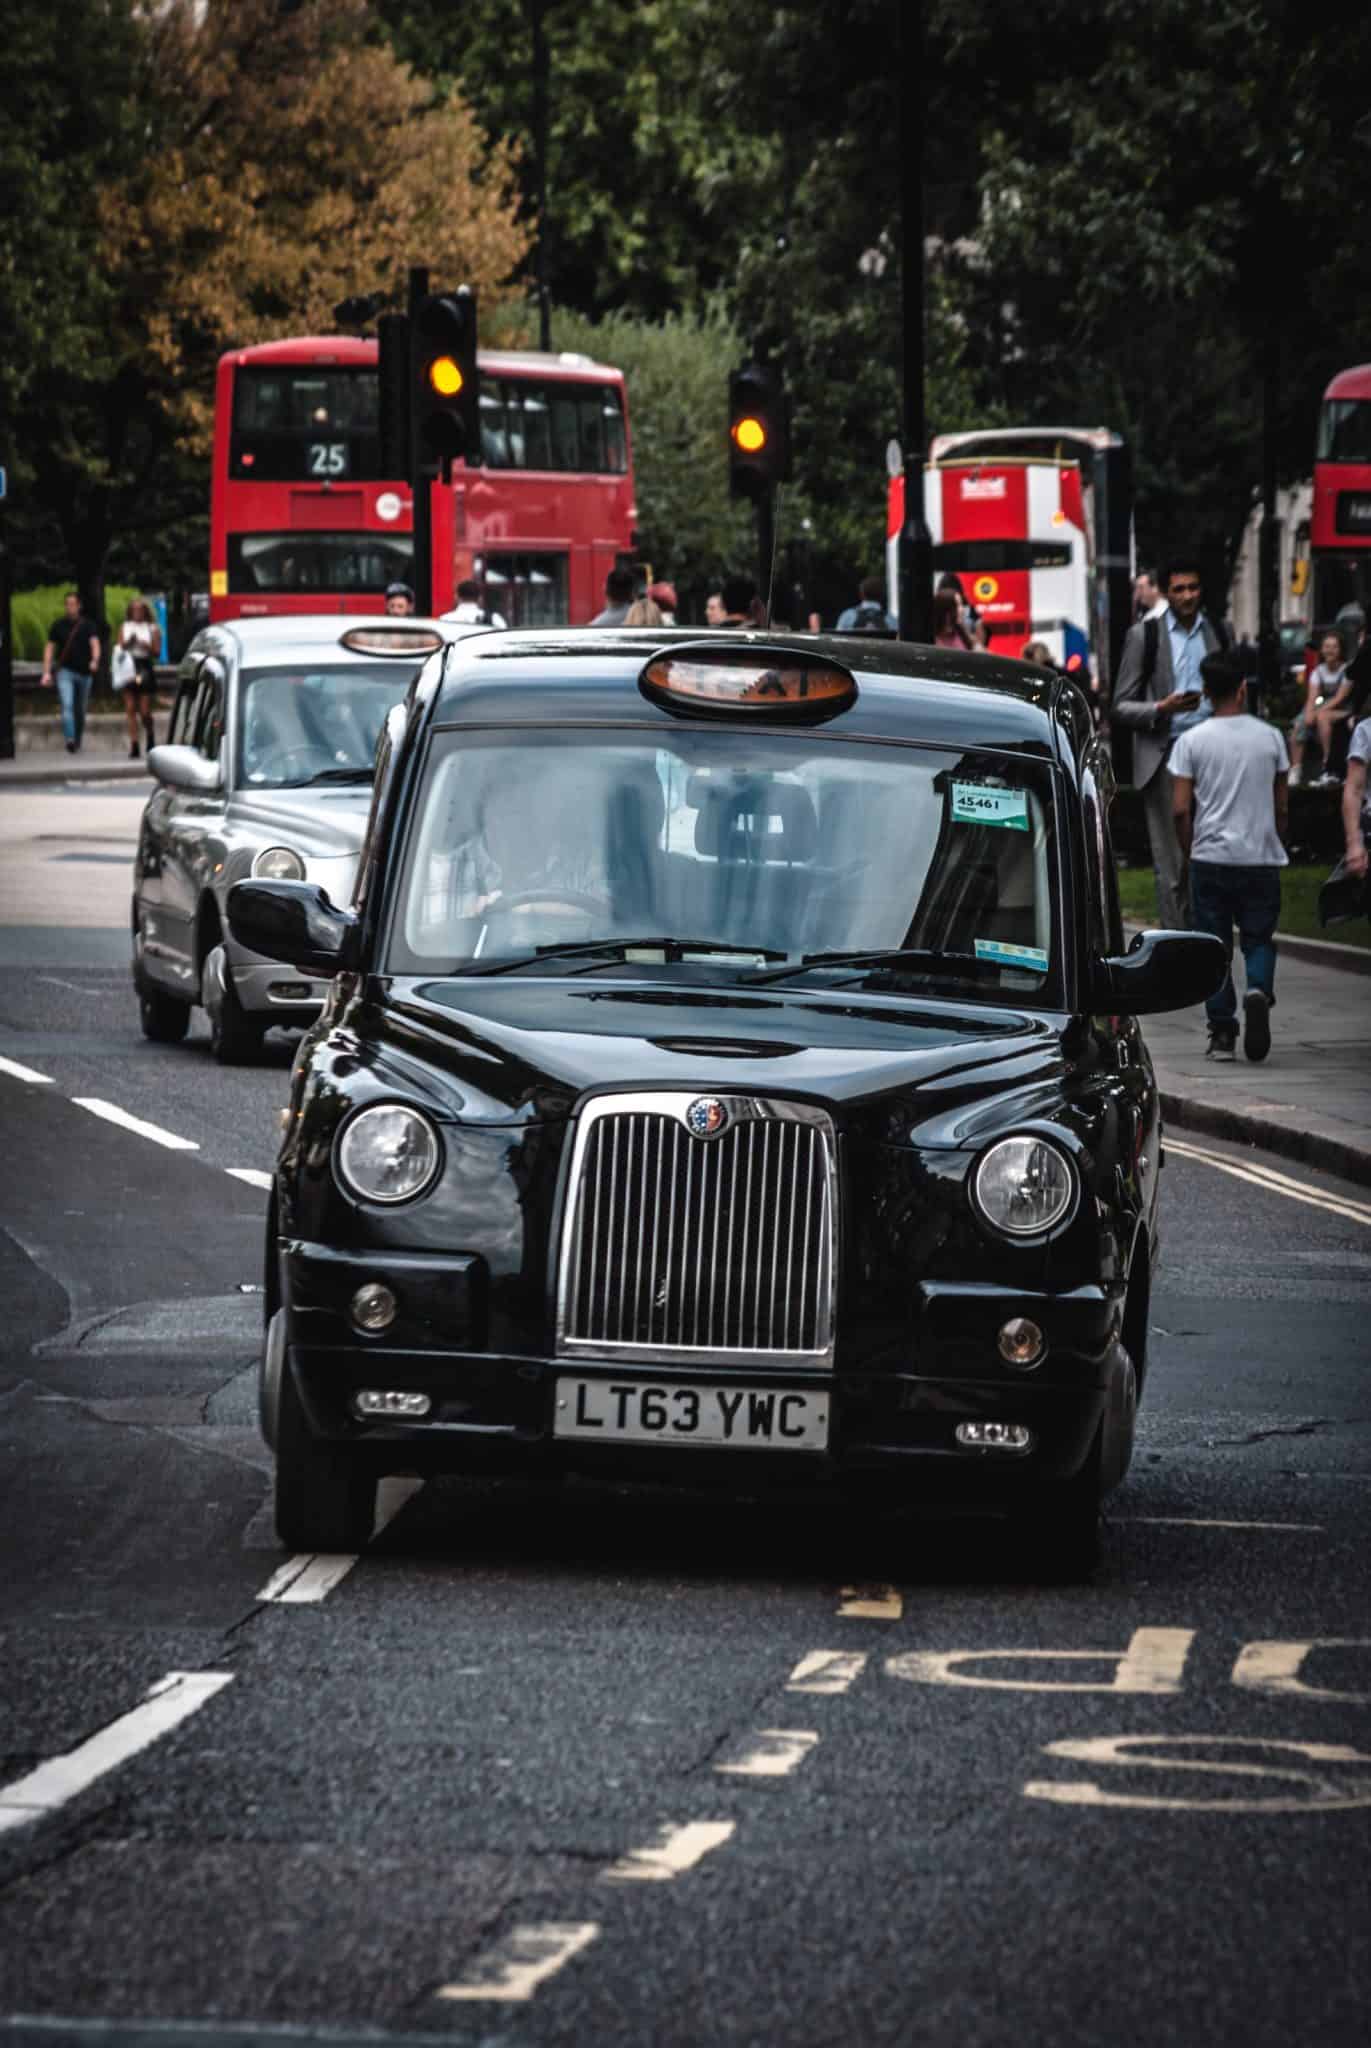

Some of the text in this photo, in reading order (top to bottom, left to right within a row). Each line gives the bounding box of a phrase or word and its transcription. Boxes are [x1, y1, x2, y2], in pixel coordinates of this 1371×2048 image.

[311, 444, 345, 474] 25
[957, 796, 999, 810] 45461
[575, 1383, 808, 1439] LT63 YWC
